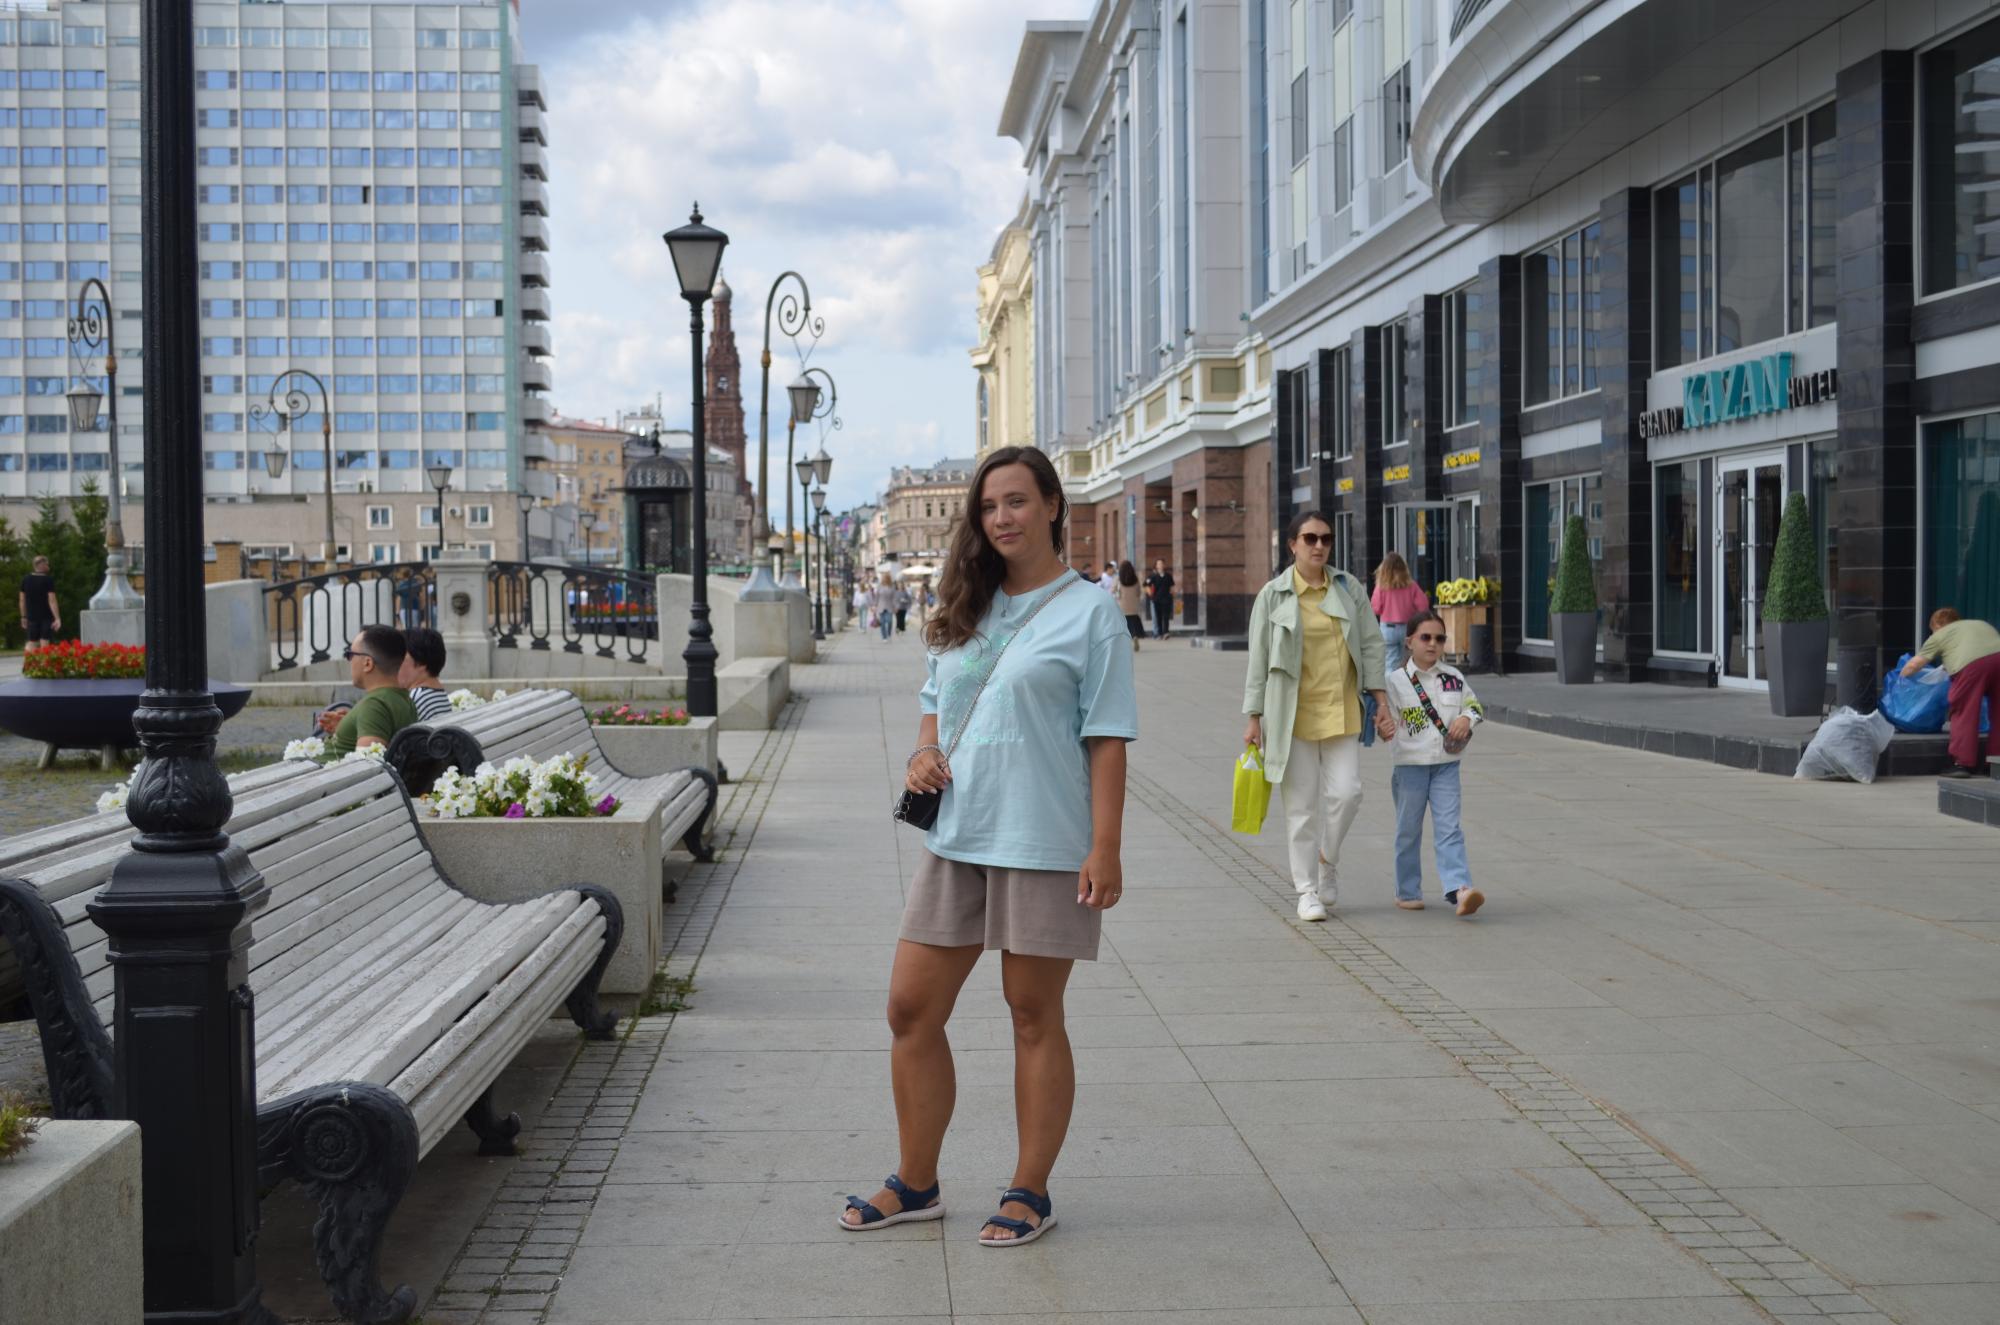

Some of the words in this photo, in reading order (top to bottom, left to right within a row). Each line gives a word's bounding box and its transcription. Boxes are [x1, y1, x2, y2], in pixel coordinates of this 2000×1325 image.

[1639, 408, 1679, 438] GRAND
[1682, 352, 1792, 428] KAZAN
[1787, 368, 1837, 409] HOTEL
